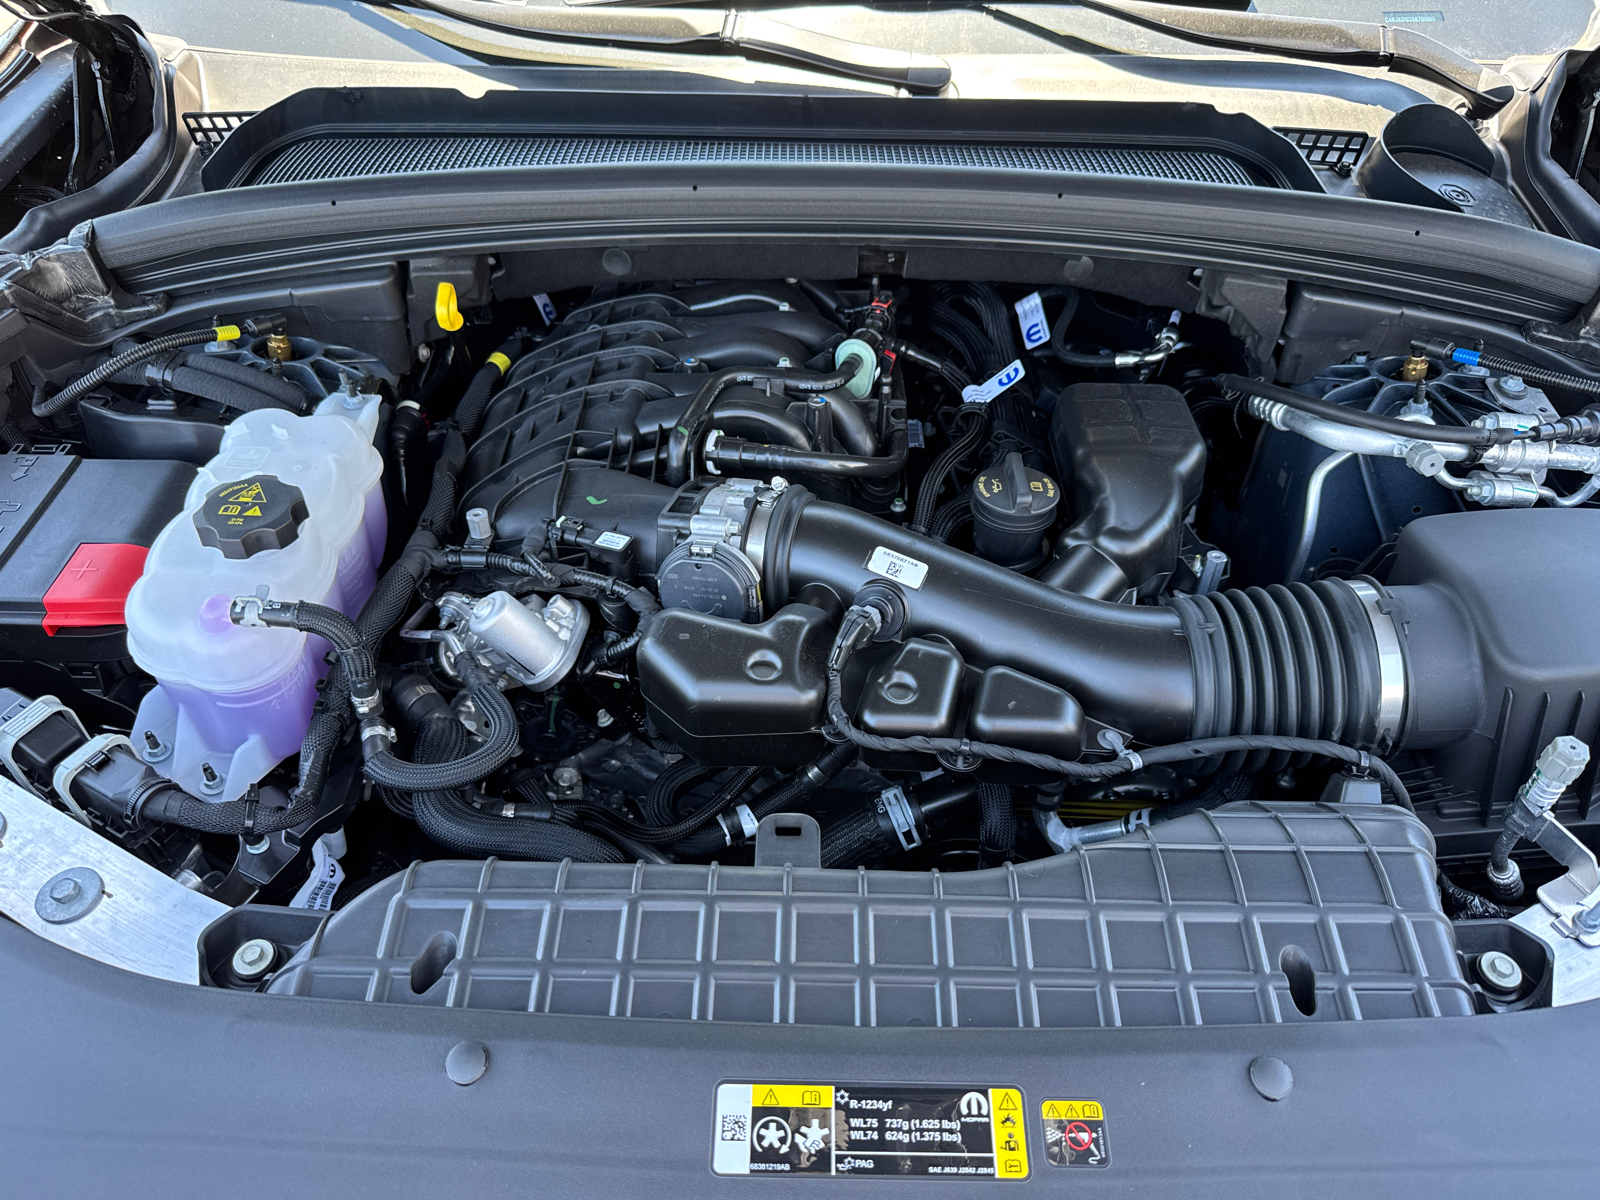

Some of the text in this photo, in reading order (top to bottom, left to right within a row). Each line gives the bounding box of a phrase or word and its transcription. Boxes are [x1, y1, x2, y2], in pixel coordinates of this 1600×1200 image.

[874, 797, 886, 814] ENG
[849, 1100, 893, 1112] R-1234yf
[850, 1118, 961, 1131] WL75 737g (1.625 lbs)
[850, 1130, 962, 1143] WL74 624g (1.375 lbs)
[749, 1162, 791, 1171] 68381219AB
[855, 1160, 874, 1168] PAG
